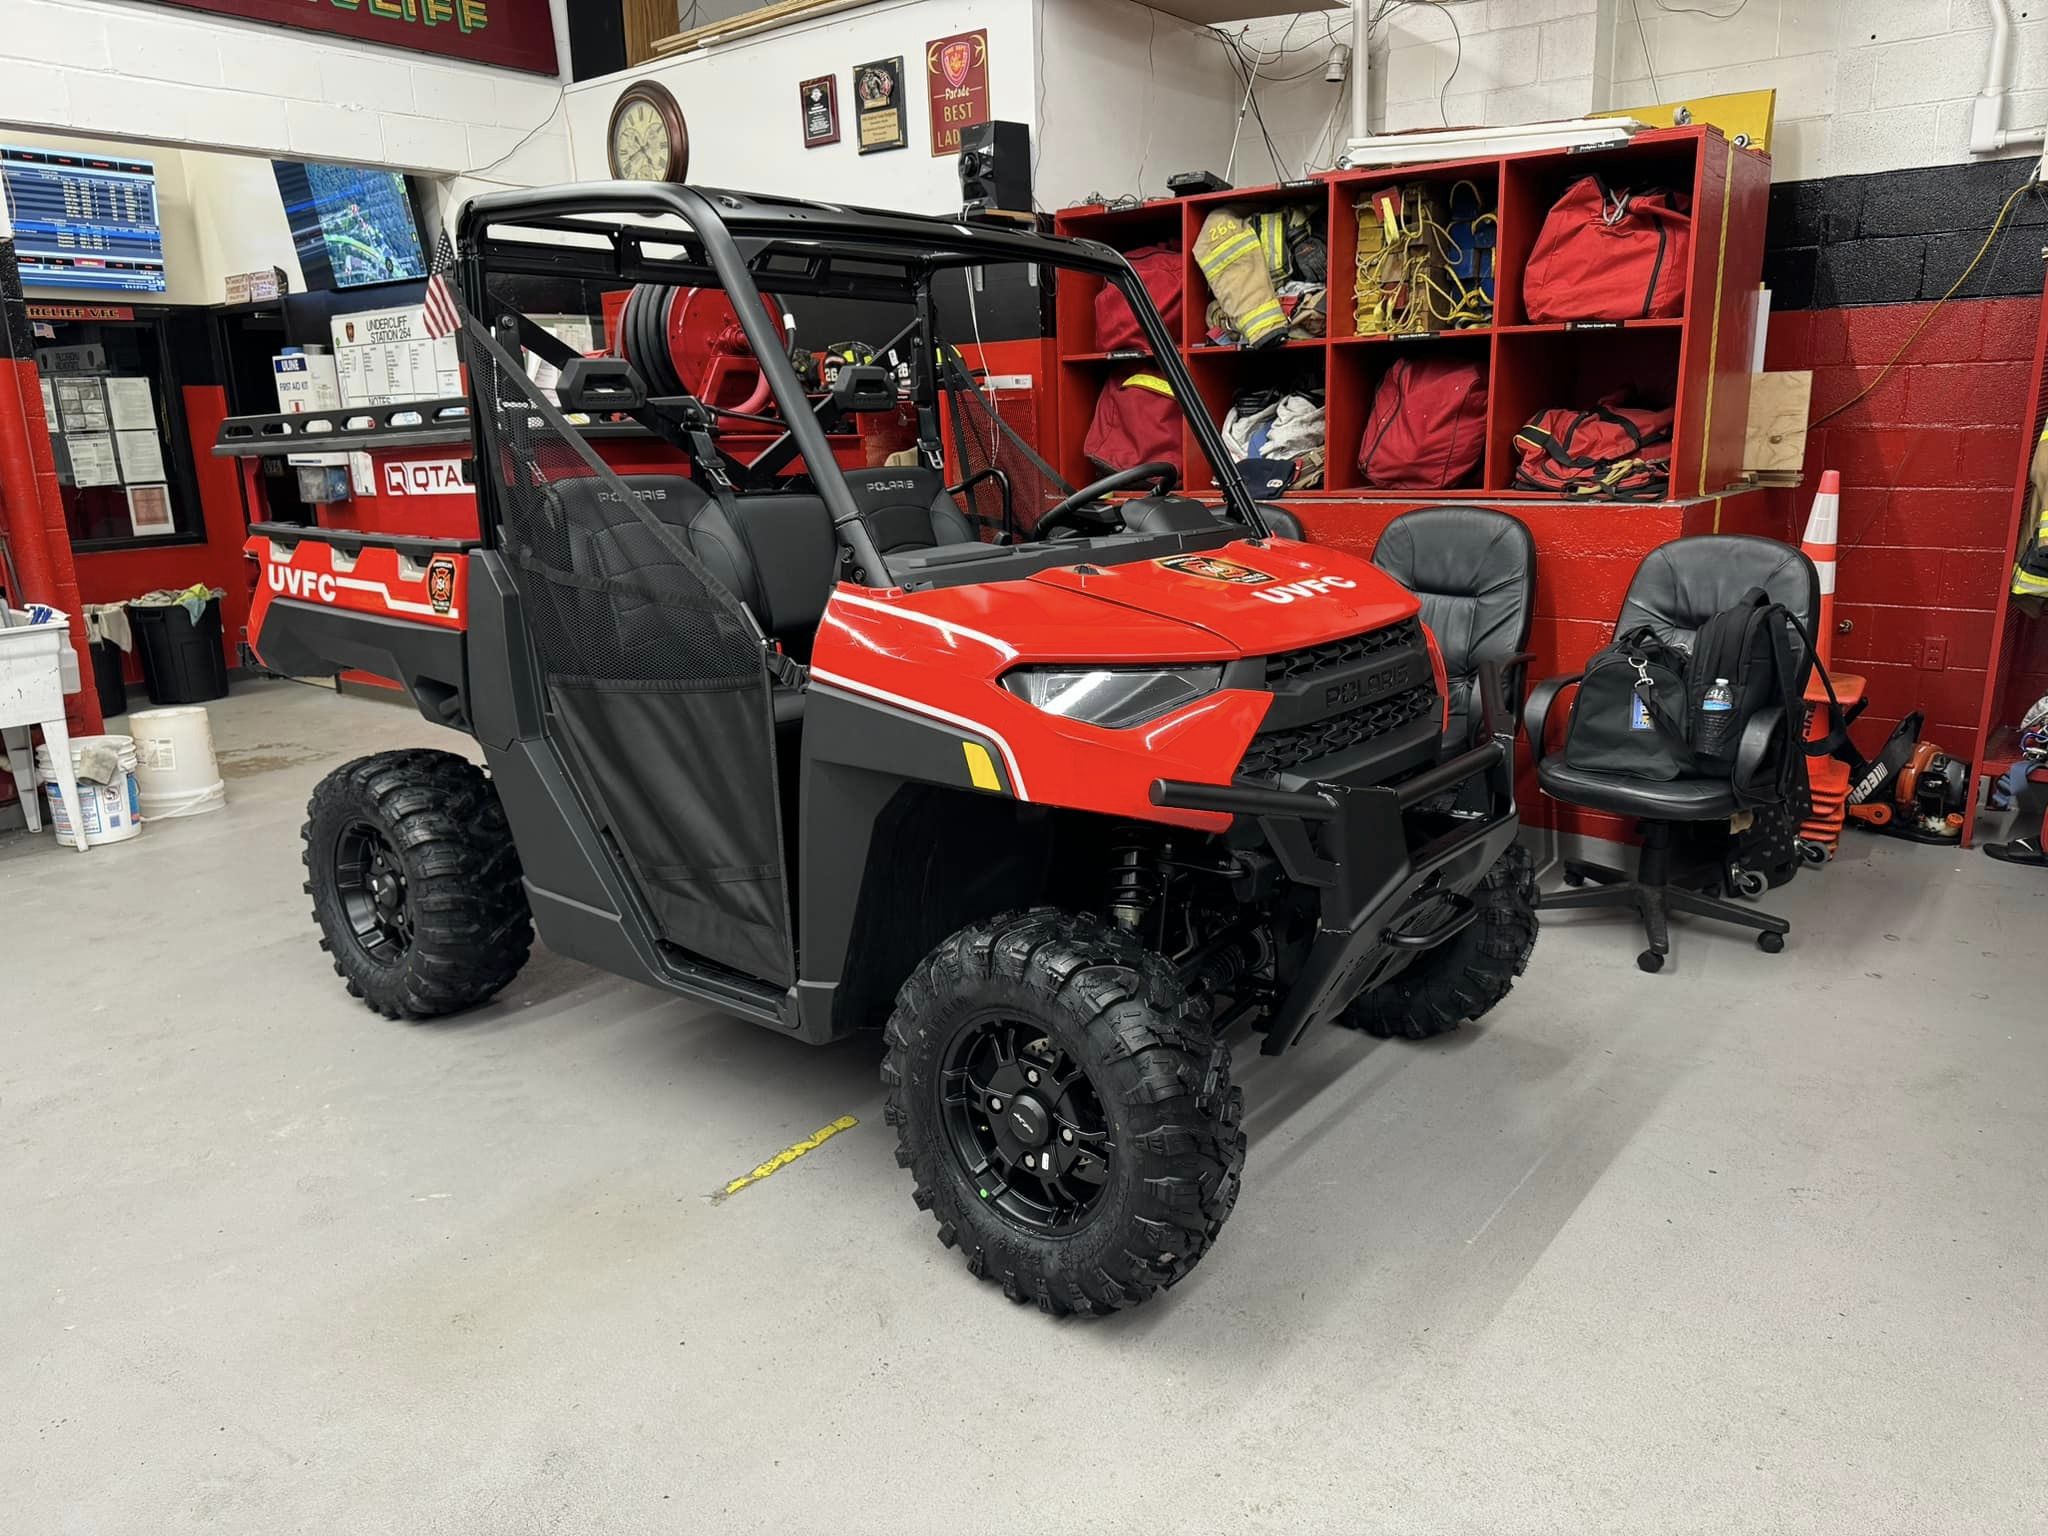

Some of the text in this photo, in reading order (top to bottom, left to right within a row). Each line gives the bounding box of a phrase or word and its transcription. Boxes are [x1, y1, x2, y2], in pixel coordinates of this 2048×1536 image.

[944, 85, 970, 101] Parade
[944, 102, 974, 122] BEST
[937, 129, 961, 148] LAD
[1209, 220, 1236, 241] 264
[26, 306, 84, 319] RCLIFF
[366, 315, 407, 331] UNDERCLIFF
[370, 329, 399, 344] STATION
[866, 480, 915, 493] POLARIS
[598, 489, 667, 502] POARIS
[268, 563, 337, 602] UVFC
[1251, 575, 1357, 604] UVFC
[1326, 663, 1409, 707] POLARIS
